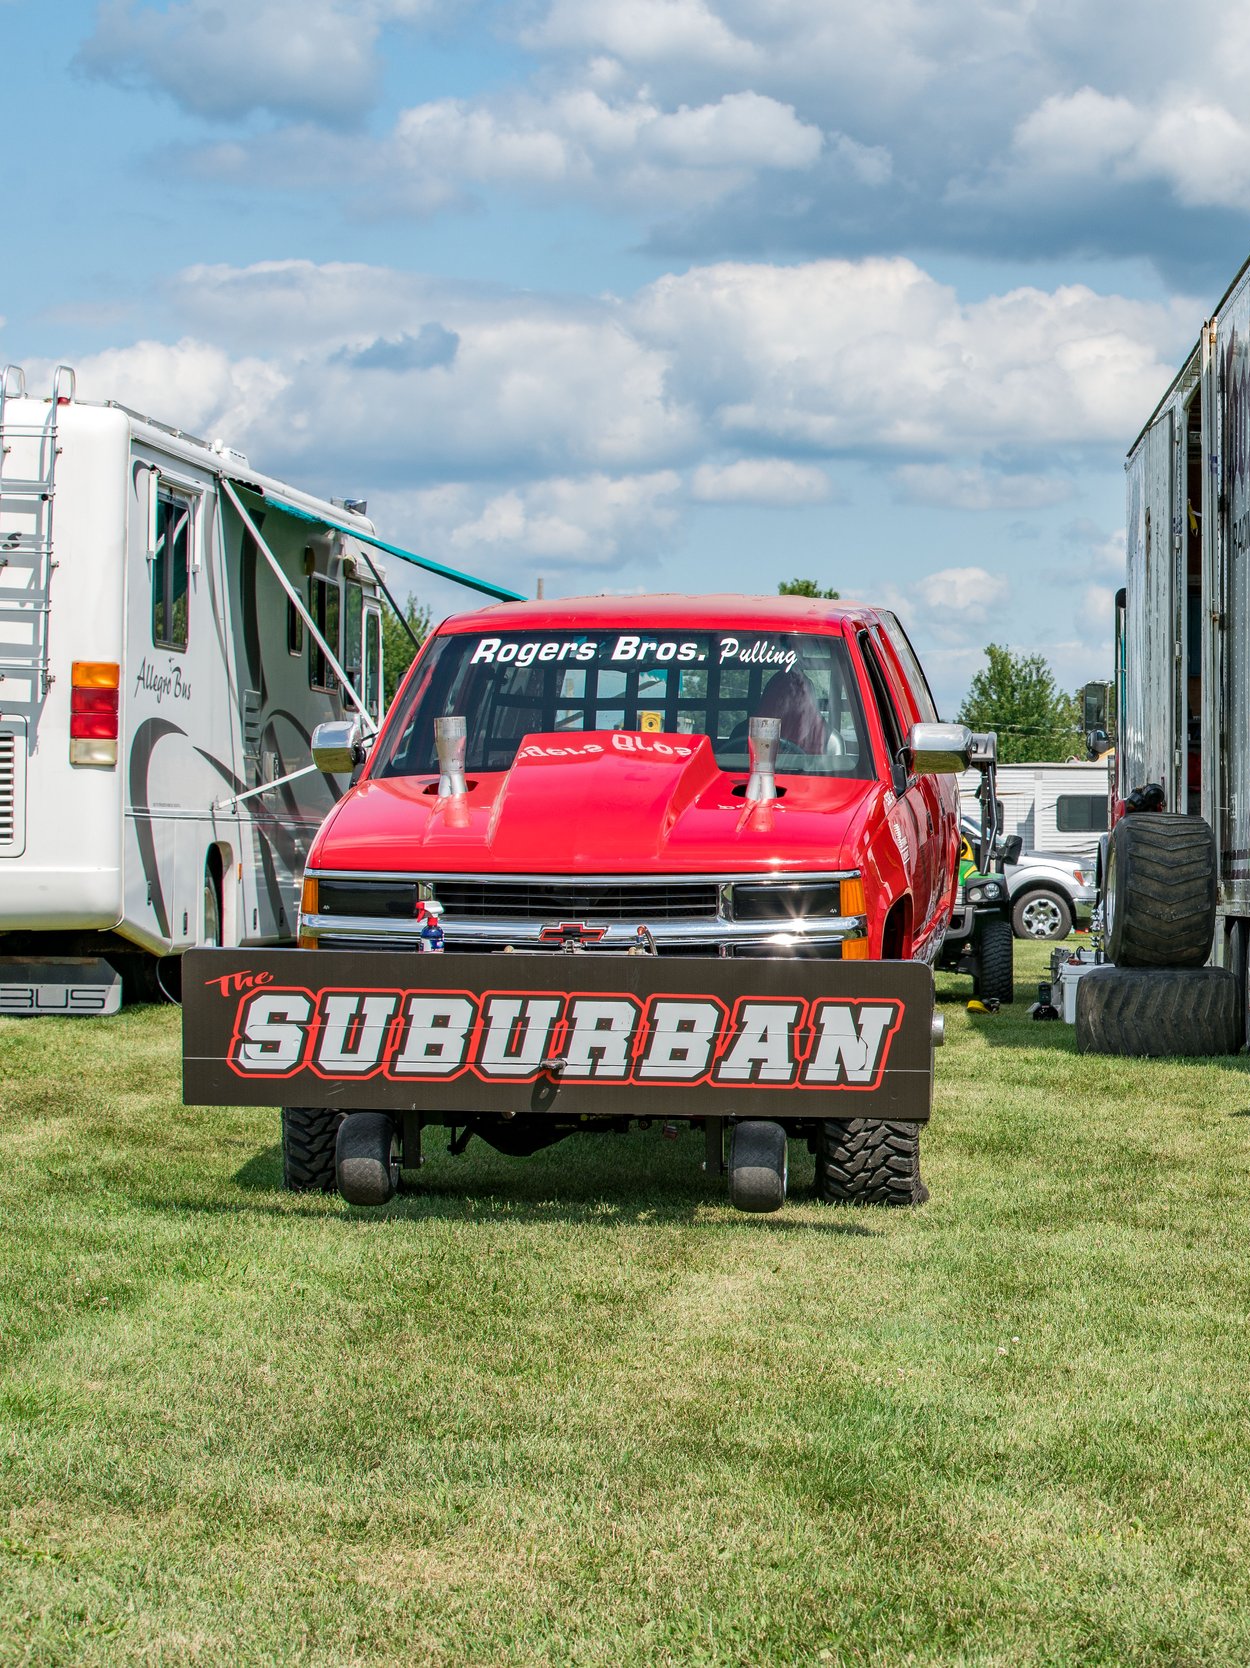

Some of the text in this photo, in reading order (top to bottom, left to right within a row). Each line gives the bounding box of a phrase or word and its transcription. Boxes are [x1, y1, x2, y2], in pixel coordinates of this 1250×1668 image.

[470, 636, 798, 673] Rogers Bros. Pulling
[134, 656, 192, 703] Allegro Bus
[205, 970, 275, 998] The
[228, 988, 903, 1089] SUBURBAN
